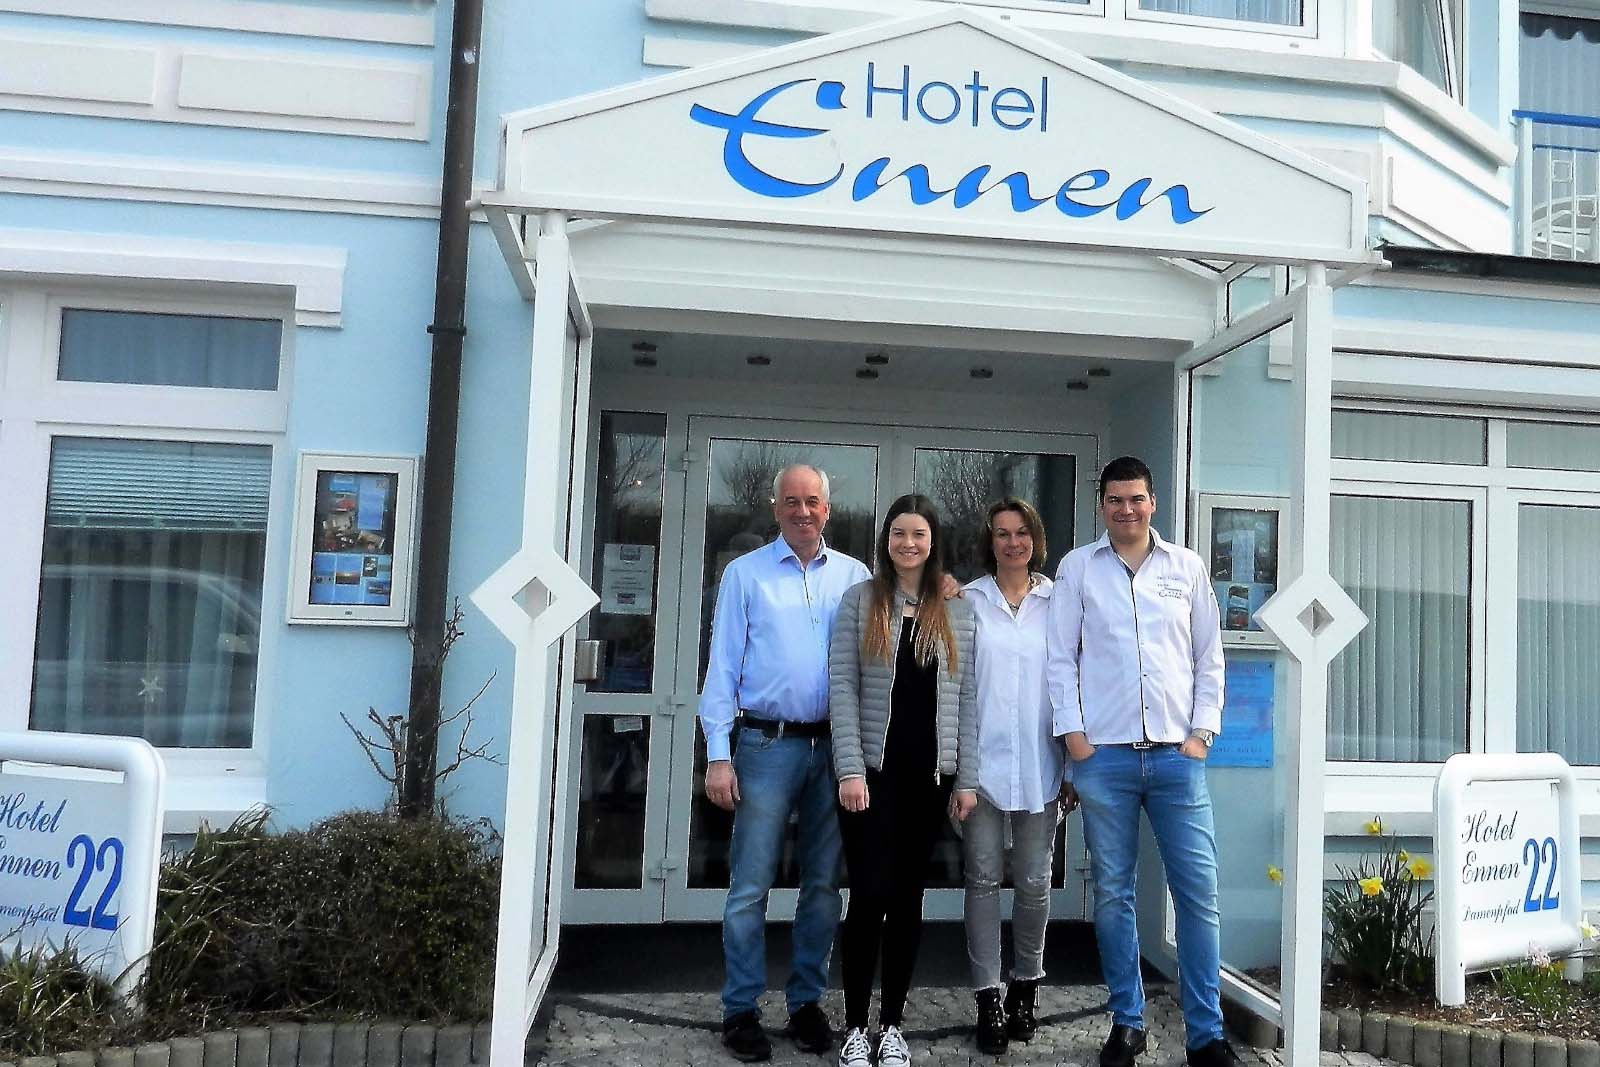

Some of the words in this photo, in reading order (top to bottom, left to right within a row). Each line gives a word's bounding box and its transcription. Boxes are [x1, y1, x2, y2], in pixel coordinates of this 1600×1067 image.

[866, 62, 1048, 132] Hotel
[690, 78, 1215, 224] Ennen
[0, 792, 67, 833] Hotel
[1461, 809, 1518, 844] Hotel
[63, 834, 124, 931] 22
[1462, 850, 1520, 885] Ennen
[1523, 836, 1560, 912] 22
